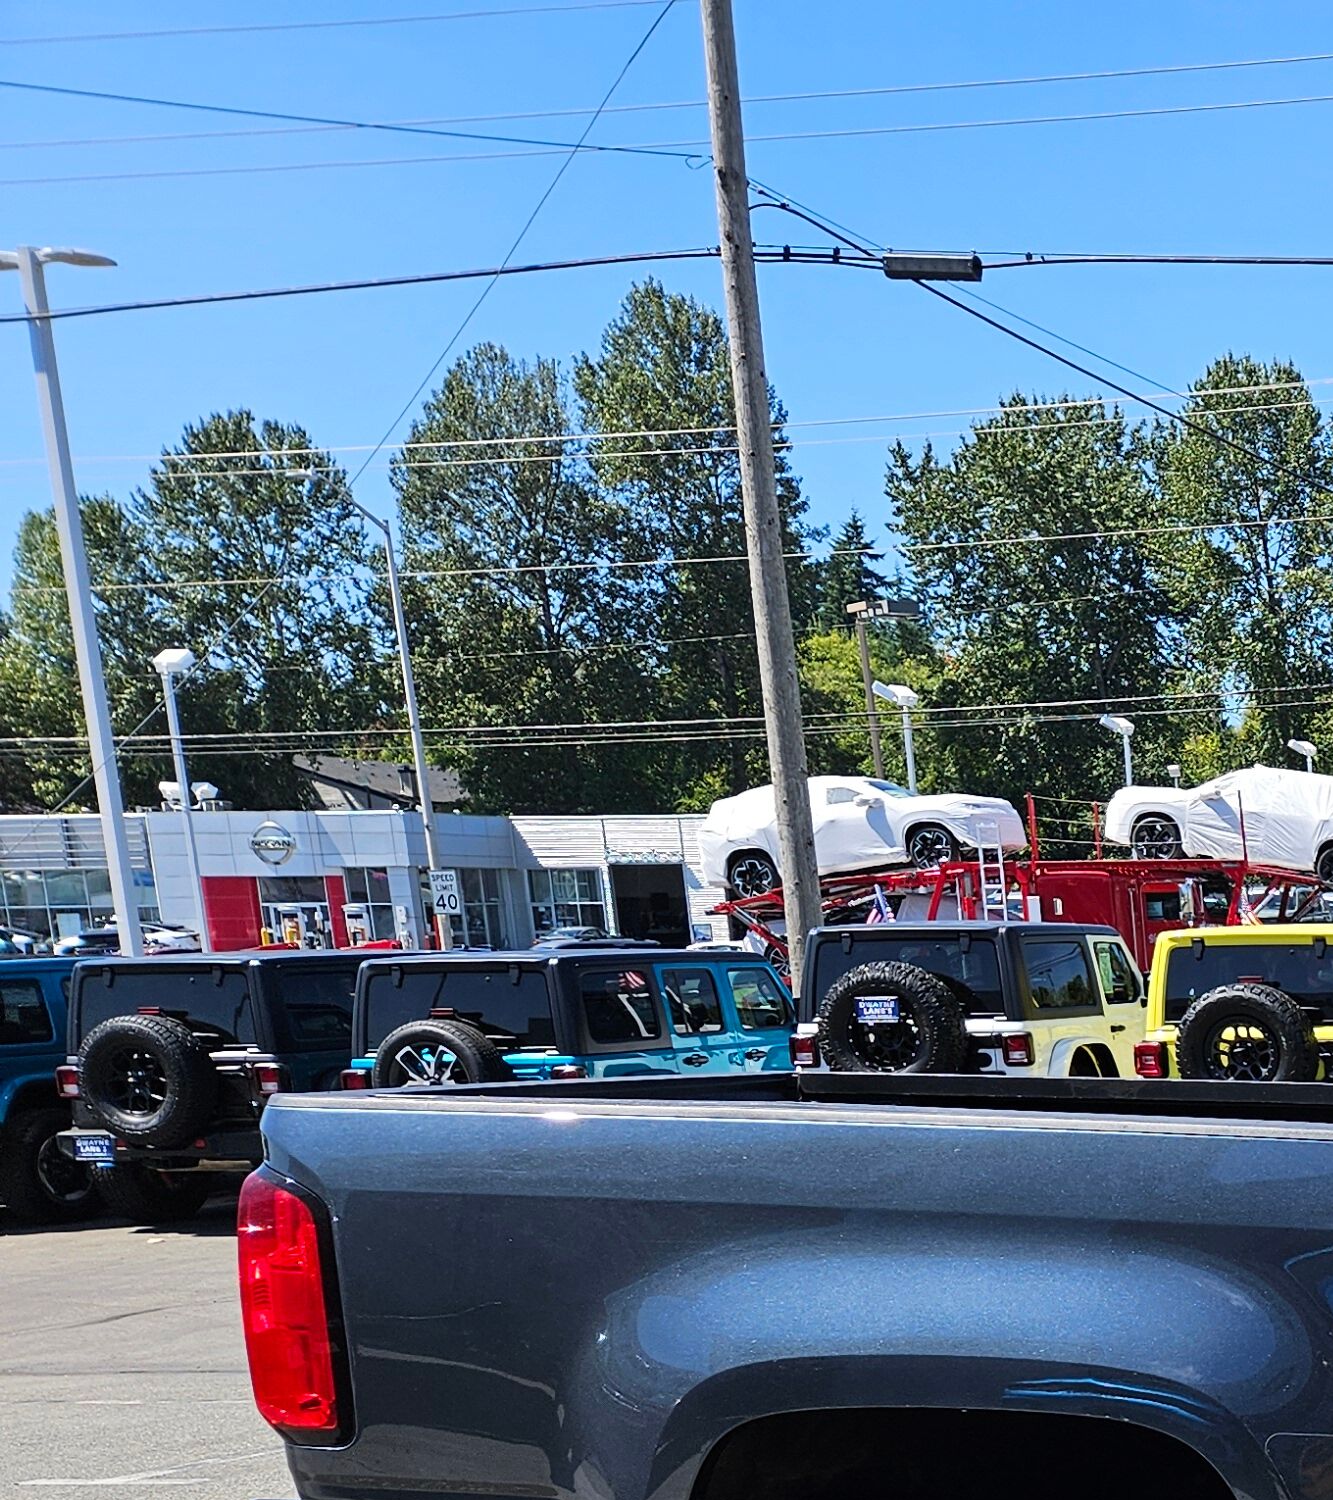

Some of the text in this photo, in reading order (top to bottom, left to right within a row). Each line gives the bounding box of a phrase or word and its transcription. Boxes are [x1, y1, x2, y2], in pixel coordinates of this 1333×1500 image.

[431, 874, 455, 882] SPEED
[435, 883, 454, 892] LIMIT
[436, 894, 457, 910] 40
